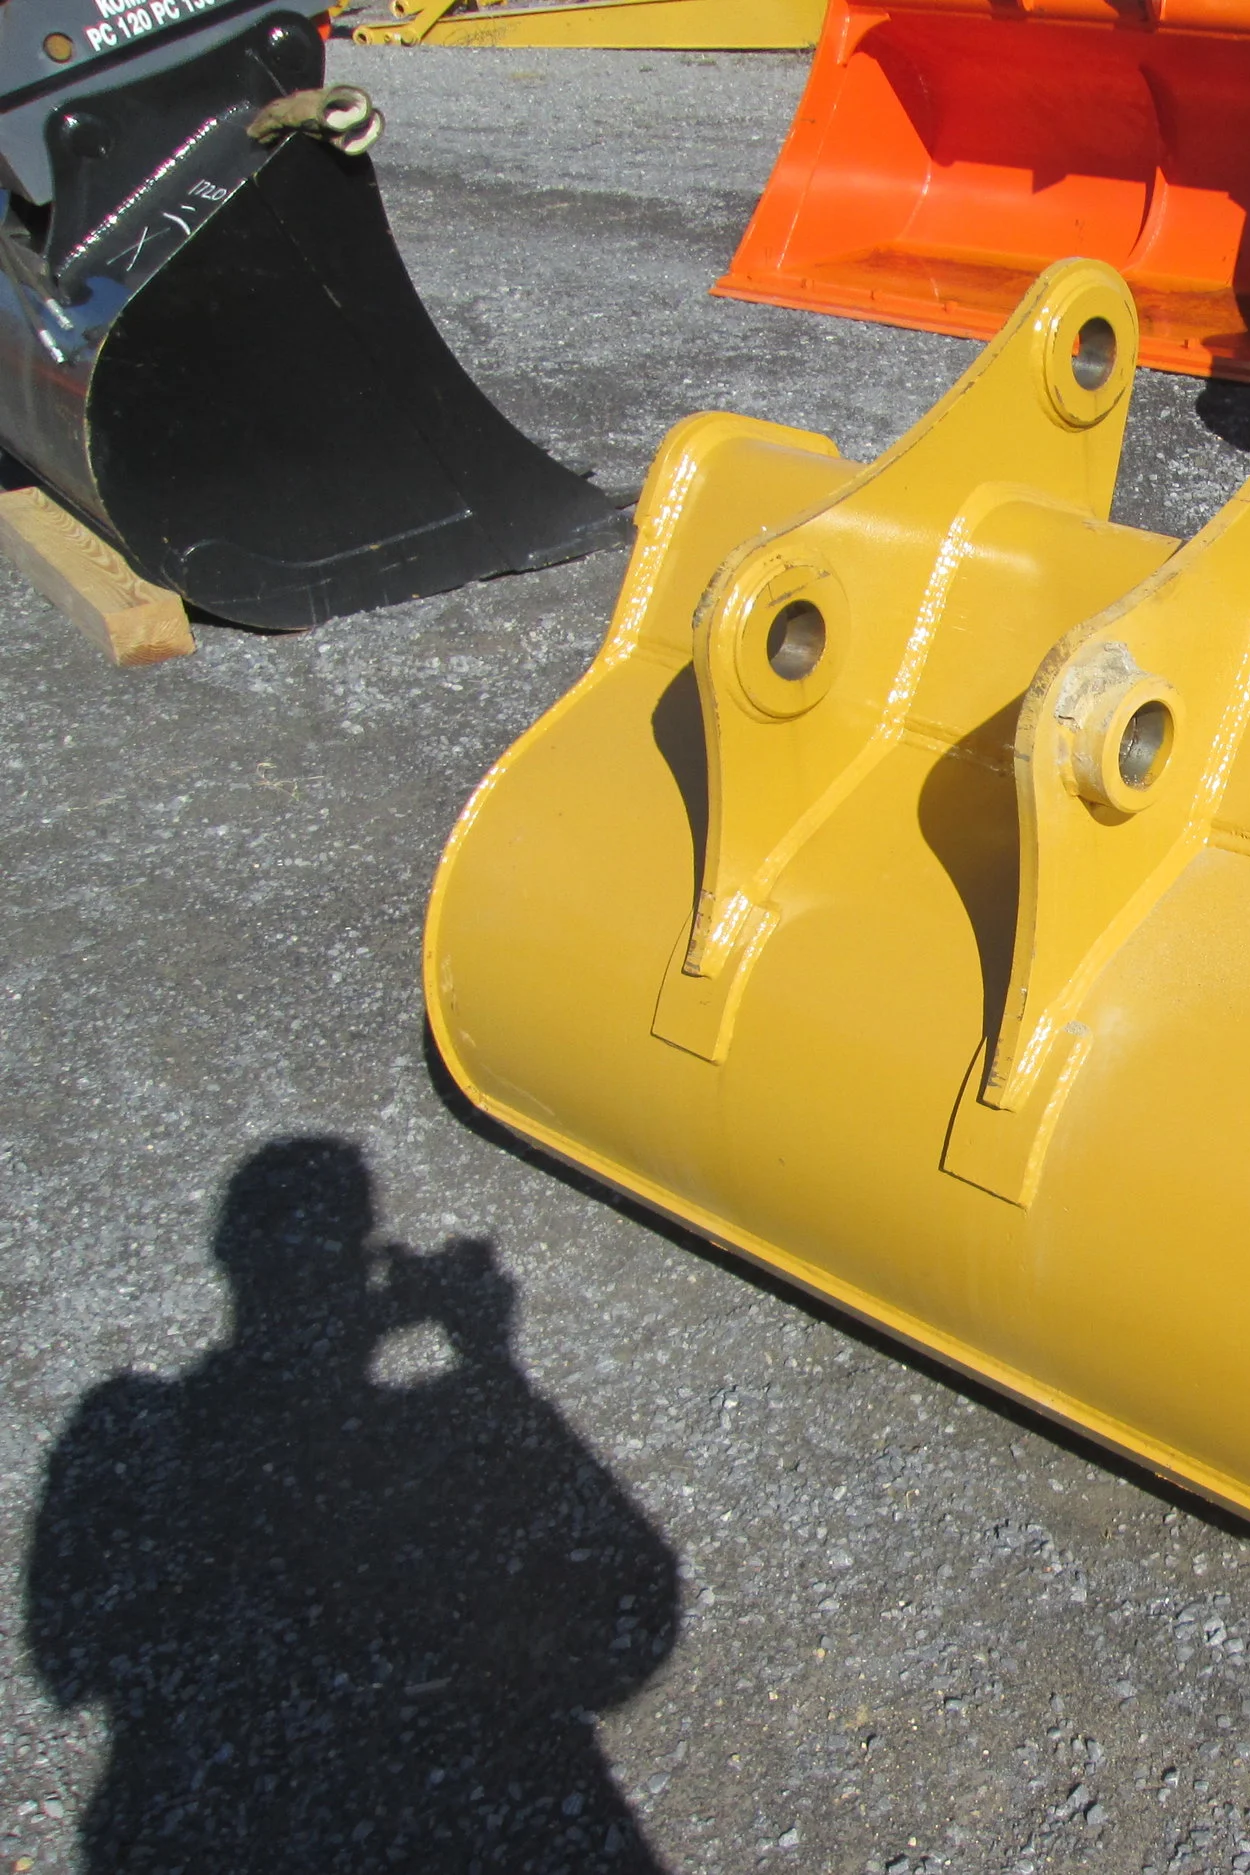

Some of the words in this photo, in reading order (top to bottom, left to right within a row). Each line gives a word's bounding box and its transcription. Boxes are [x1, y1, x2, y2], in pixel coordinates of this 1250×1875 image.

[86, 22, 117, 52] PC
[117, 8, 153, 39] 120
[149, 0, 181, 26] PC
